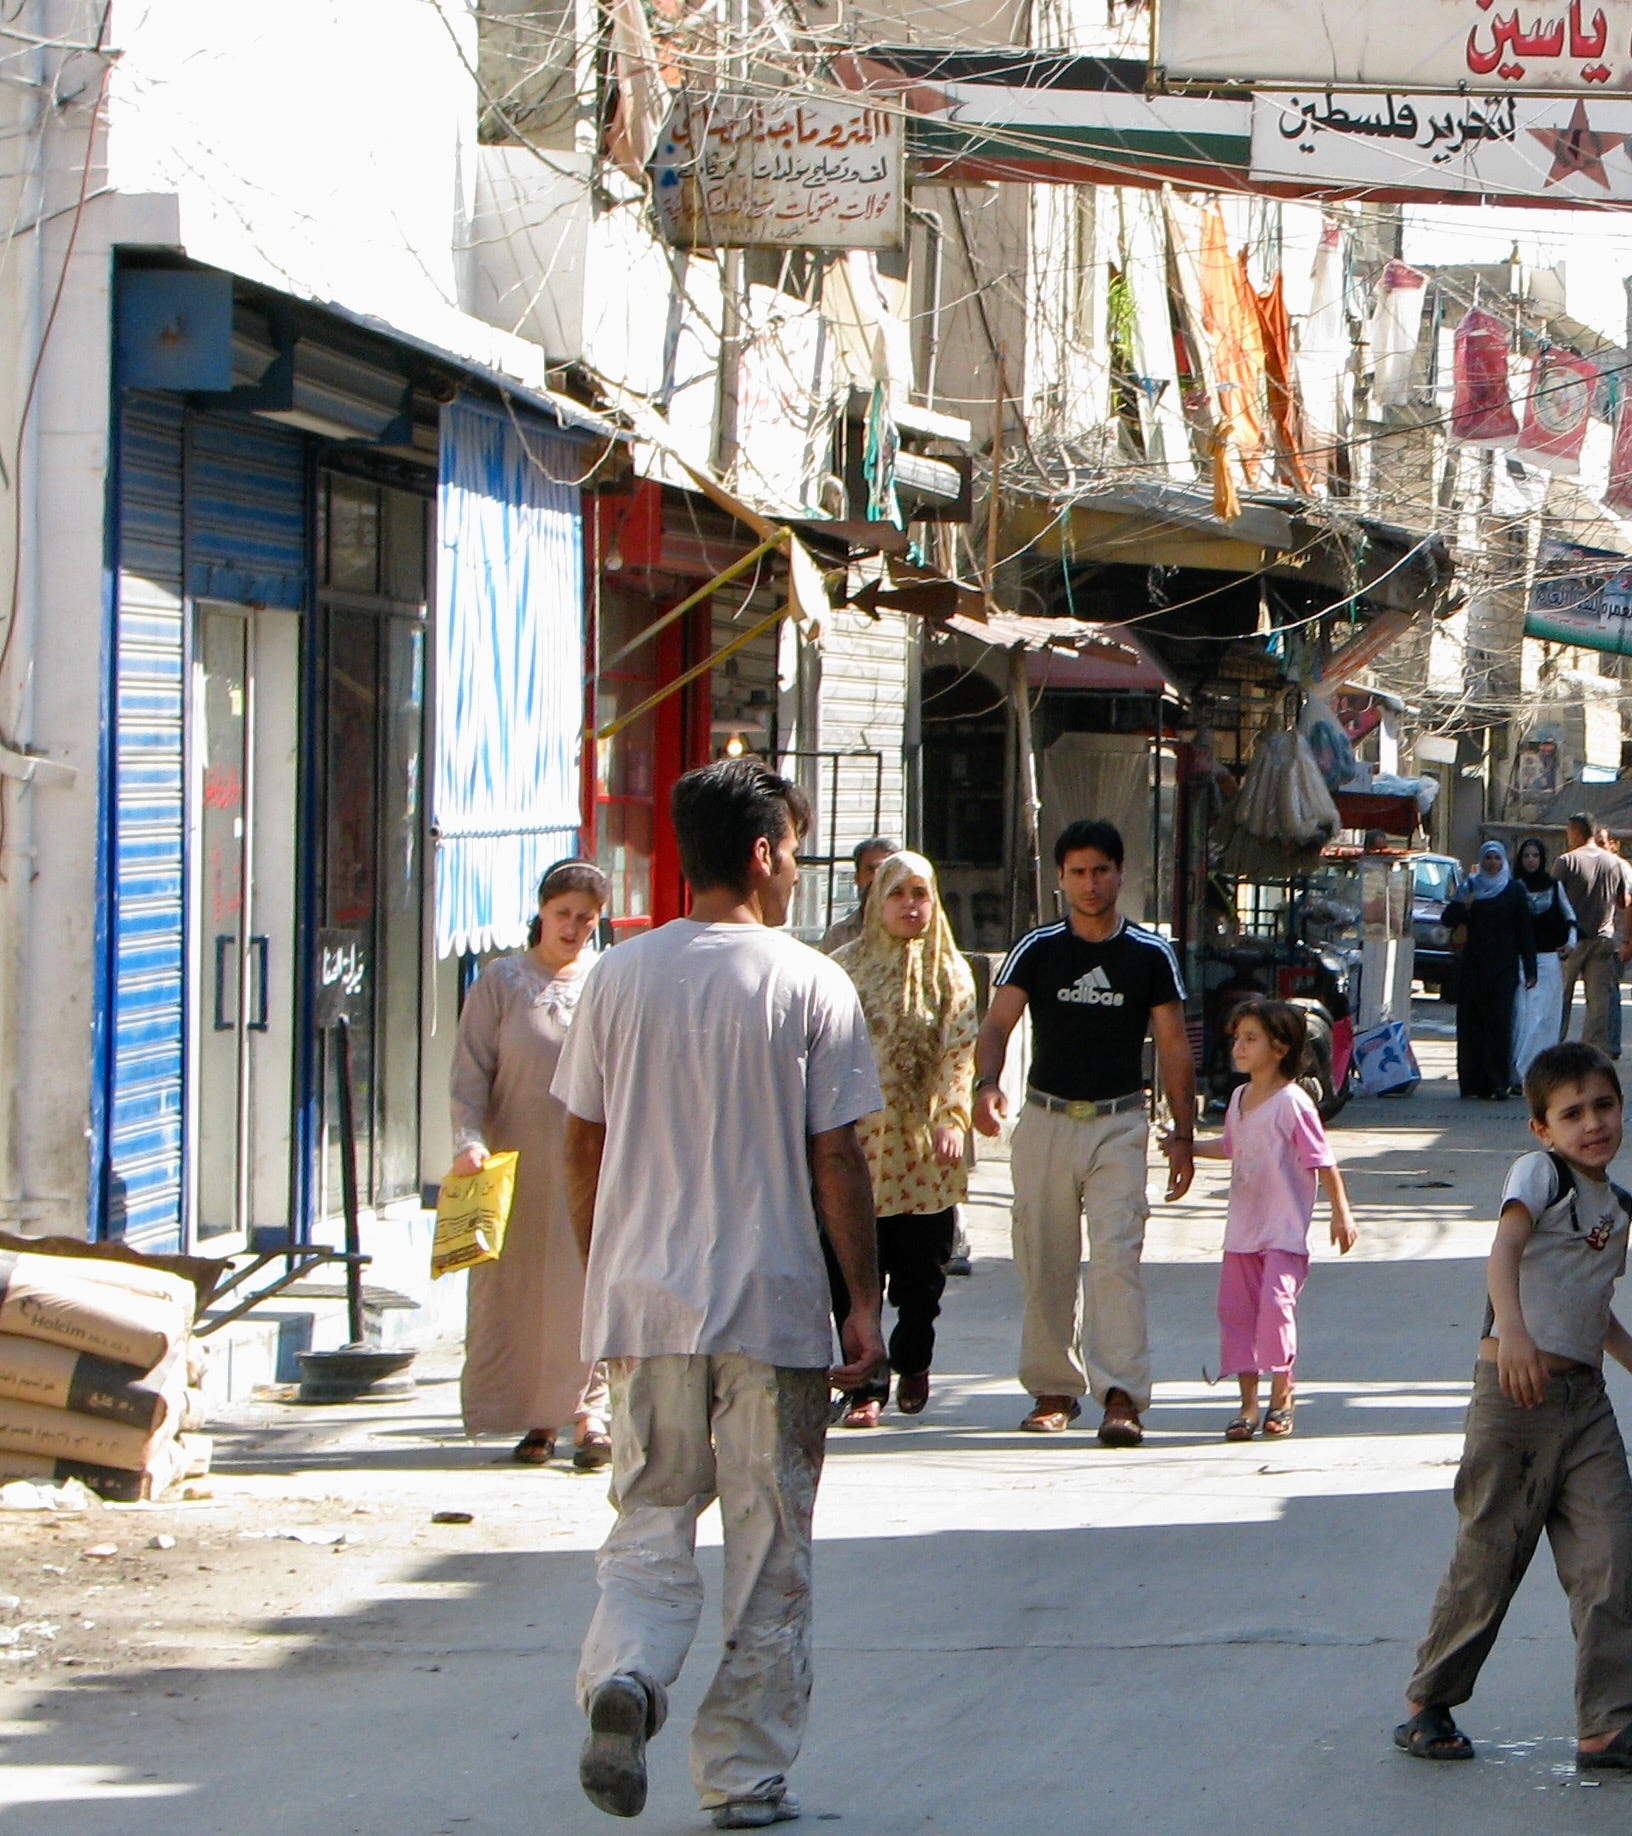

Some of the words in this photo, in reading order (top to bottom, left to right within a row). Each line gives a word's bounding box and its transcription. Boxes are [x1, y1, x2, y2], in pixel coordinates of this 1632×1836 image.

[1278, 93, 1419, 154] فلسطين
[1422, 96, 1517, 163] لتحرير
[31, 1314, 86, 1340] Holcim
